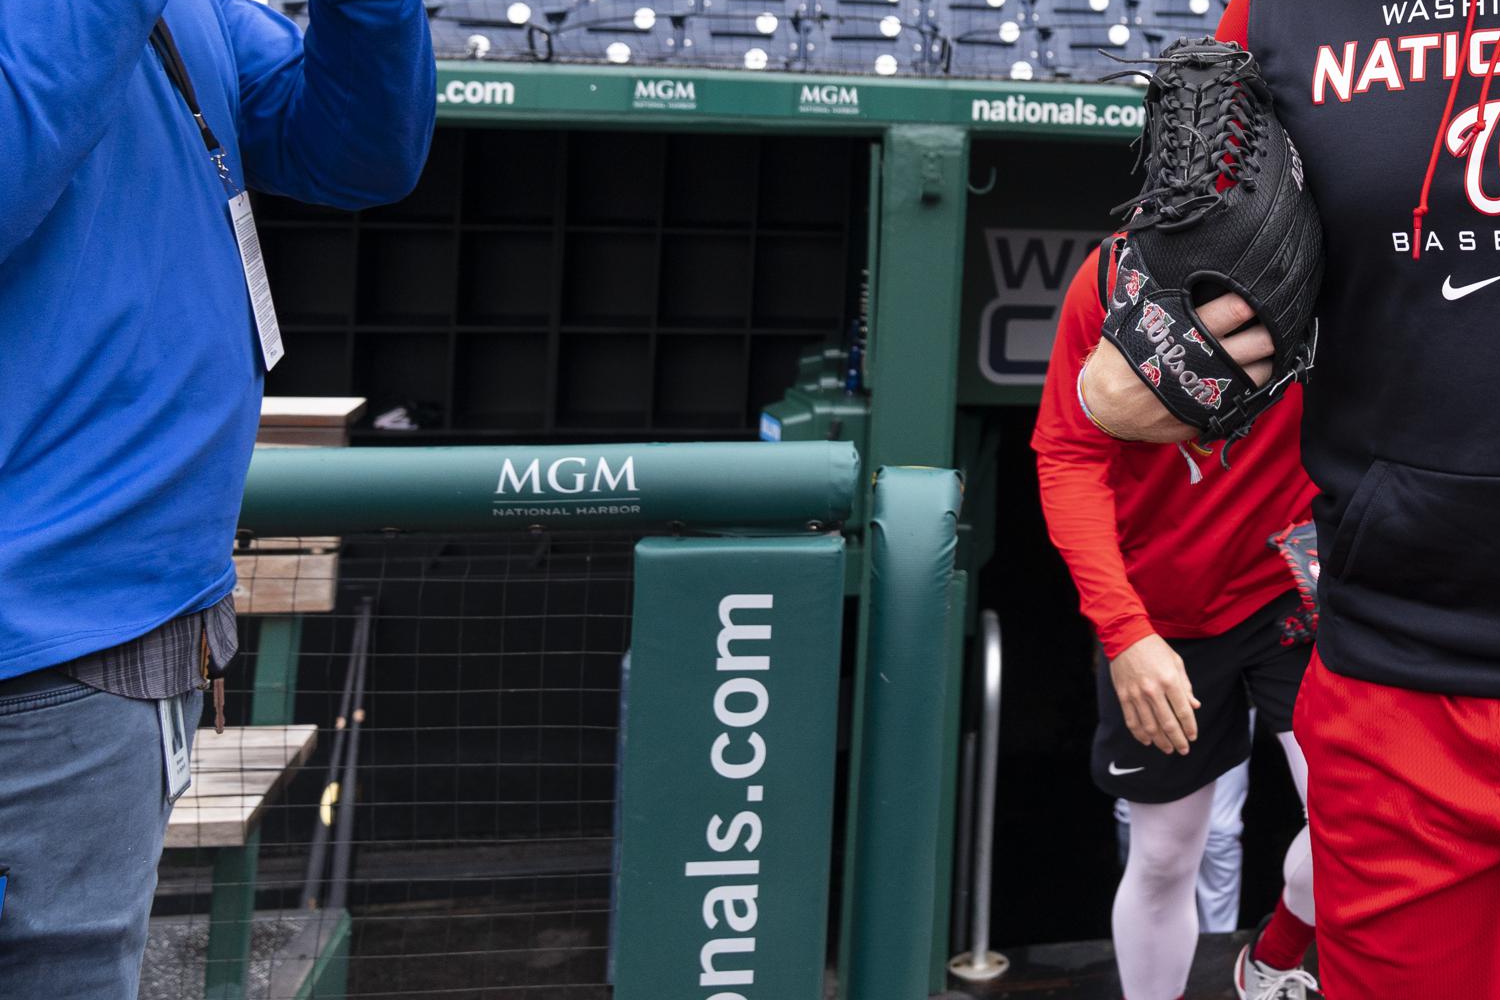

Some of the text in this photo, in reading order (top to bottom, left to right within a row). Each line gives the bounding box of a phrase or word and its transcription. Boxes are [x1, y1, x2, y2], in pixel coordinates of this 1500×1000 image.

[634, 80, 696, 101] MGM
[800, 84, 858, 105] MGM
[1141, 306, 1213, 402] Wilson
[493, 455, 641, 494] MGM
[492, 504, 641, 517] NATIONAL HARBOR
[684, 592, 775, 1000] nals.com
